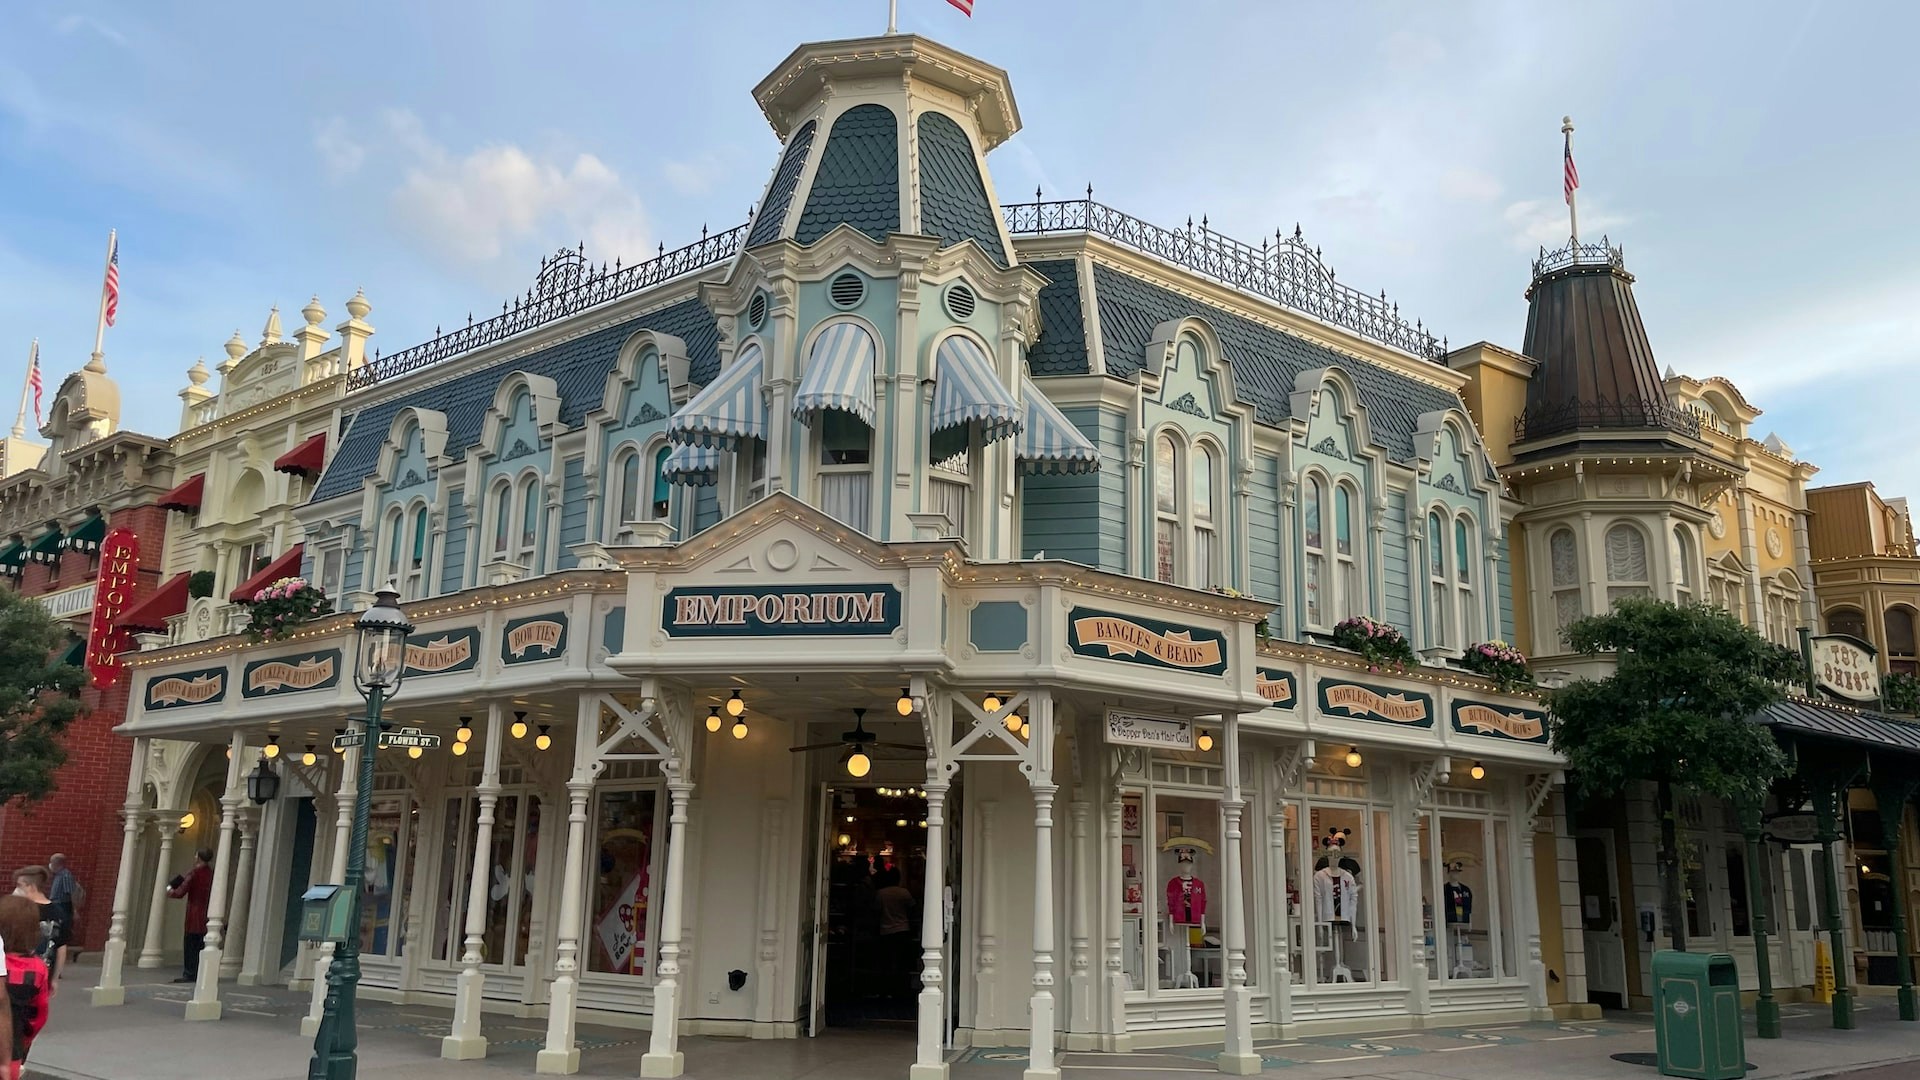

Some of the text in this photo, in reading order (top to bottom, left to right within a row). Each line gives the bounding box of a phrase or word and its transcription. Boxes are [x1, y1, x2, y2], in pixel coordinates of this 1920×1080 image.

[97, 545, 132, 667] EMPORIUM
[672, 592, 886, 625] EMPORIUM
[514, 624, 557, 647] BOW TIES
[1096, 621, 1204, 663] BANGLES & BEADS
[427, 643, 466, 667] BANGLES
[1830, 644, 1859, 669] TOY
[292, 664, 328, 685] BUTTONS
[1823, 662, 1870, 692] CHEST
[1257, 684, 1287, 699] OCHES
[1333, 688, 1420, 719] BOWLERS & BONNETS
[1468, 708, 1532, 735] BUTTONS & BOWS
[388, 735, 432, 747] FLOWER ST.
[1175, 731, 1190, 743] Cuts
